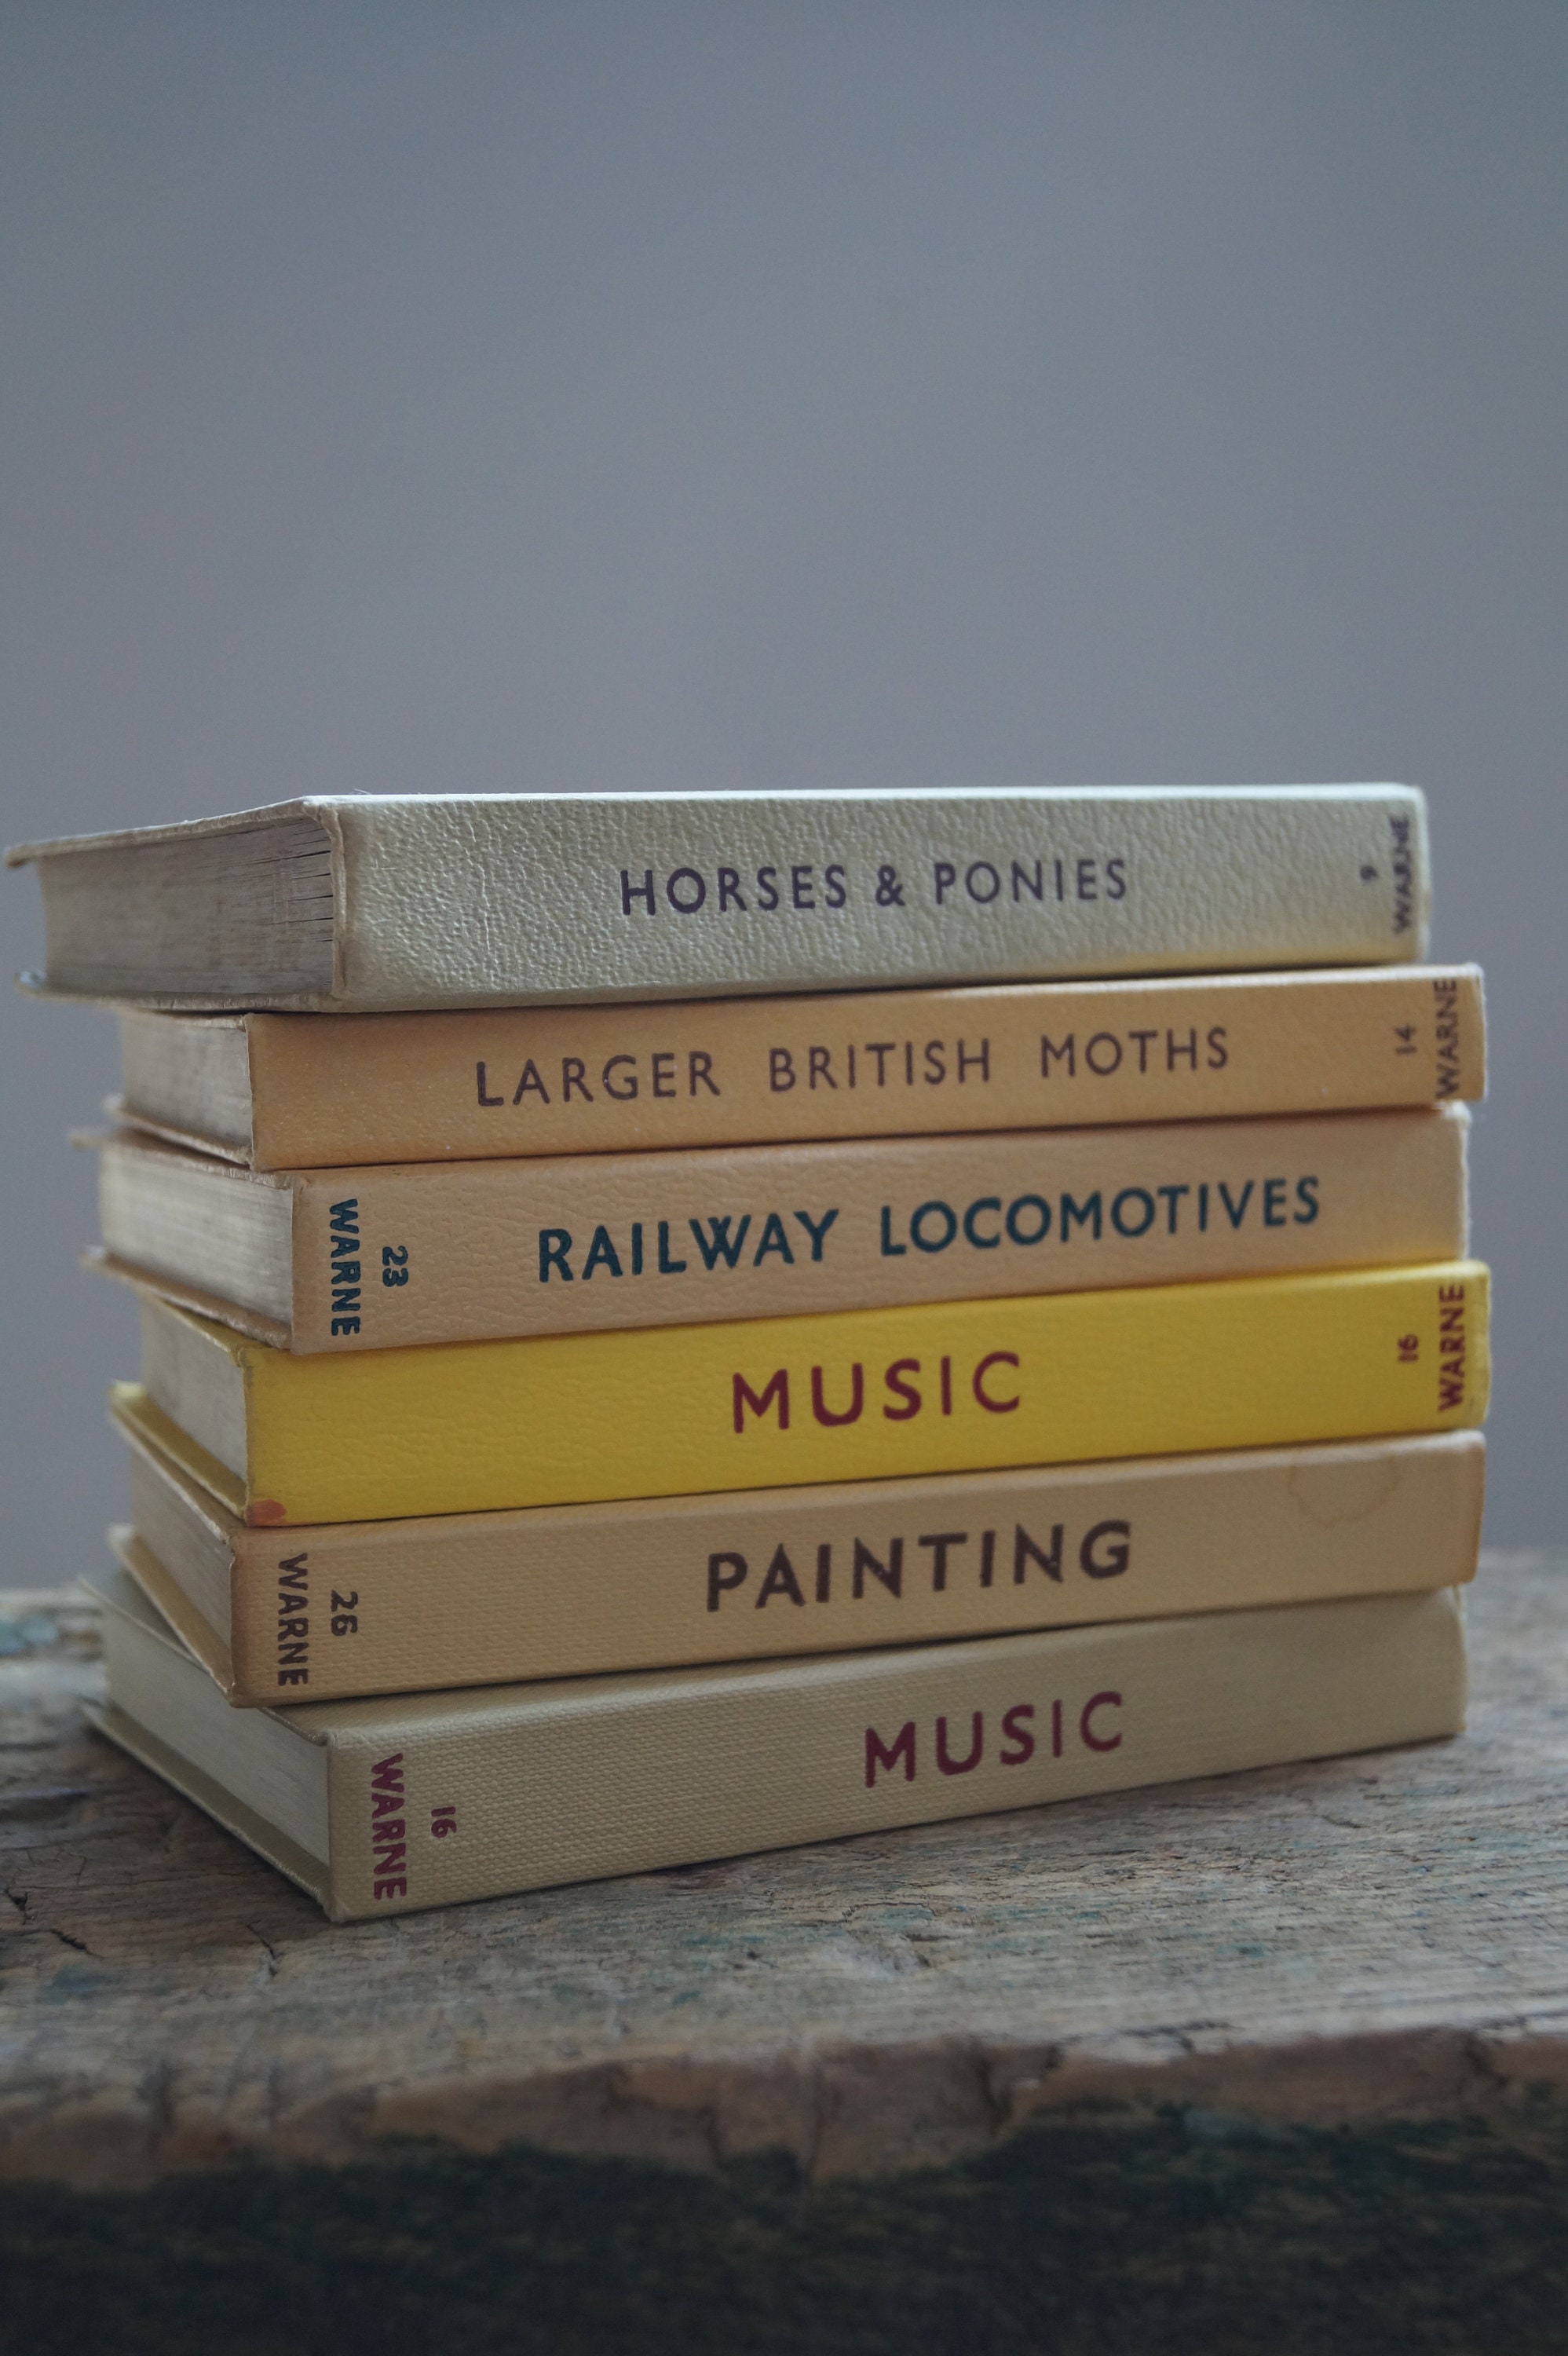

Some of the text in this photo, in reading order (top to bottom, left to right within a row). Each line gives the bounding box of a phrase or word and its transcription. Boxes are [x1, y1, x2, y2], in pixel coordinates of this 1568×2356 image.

[620, 858, 1128, 916] HORSES & PONIES
[1390, 815, 1413, 935] WARNE
[475, 1026, 1228, 1107] LARGER BRITISH MOTHS
[1394, 1025, 1416, 1055] 14
[1434, 979, 1460, 1099] WARNE
[328, 1198, 361, 1337] WARNE
[381, 1244, 408, 1288] 23
[537, 1176, 1321, 1282] RAILWAY LOCOMOTIVES
[733, 1351, 1022, 1433] MUSIC
[1398, 1334, 1419, 1363] 16
[1438, 1285, 1465, 1412] WARNE
[706, 1520, 1131, 1612] PAINTING
[278, 1553, 309, 1688] WARNE
[331, 1589, 358, 1637] 26
[864, 1691, 1124, 1788] MUSIC
[371, 1752, 407, 1901] WARNE
[430, 1806, 456, 1838] 16
